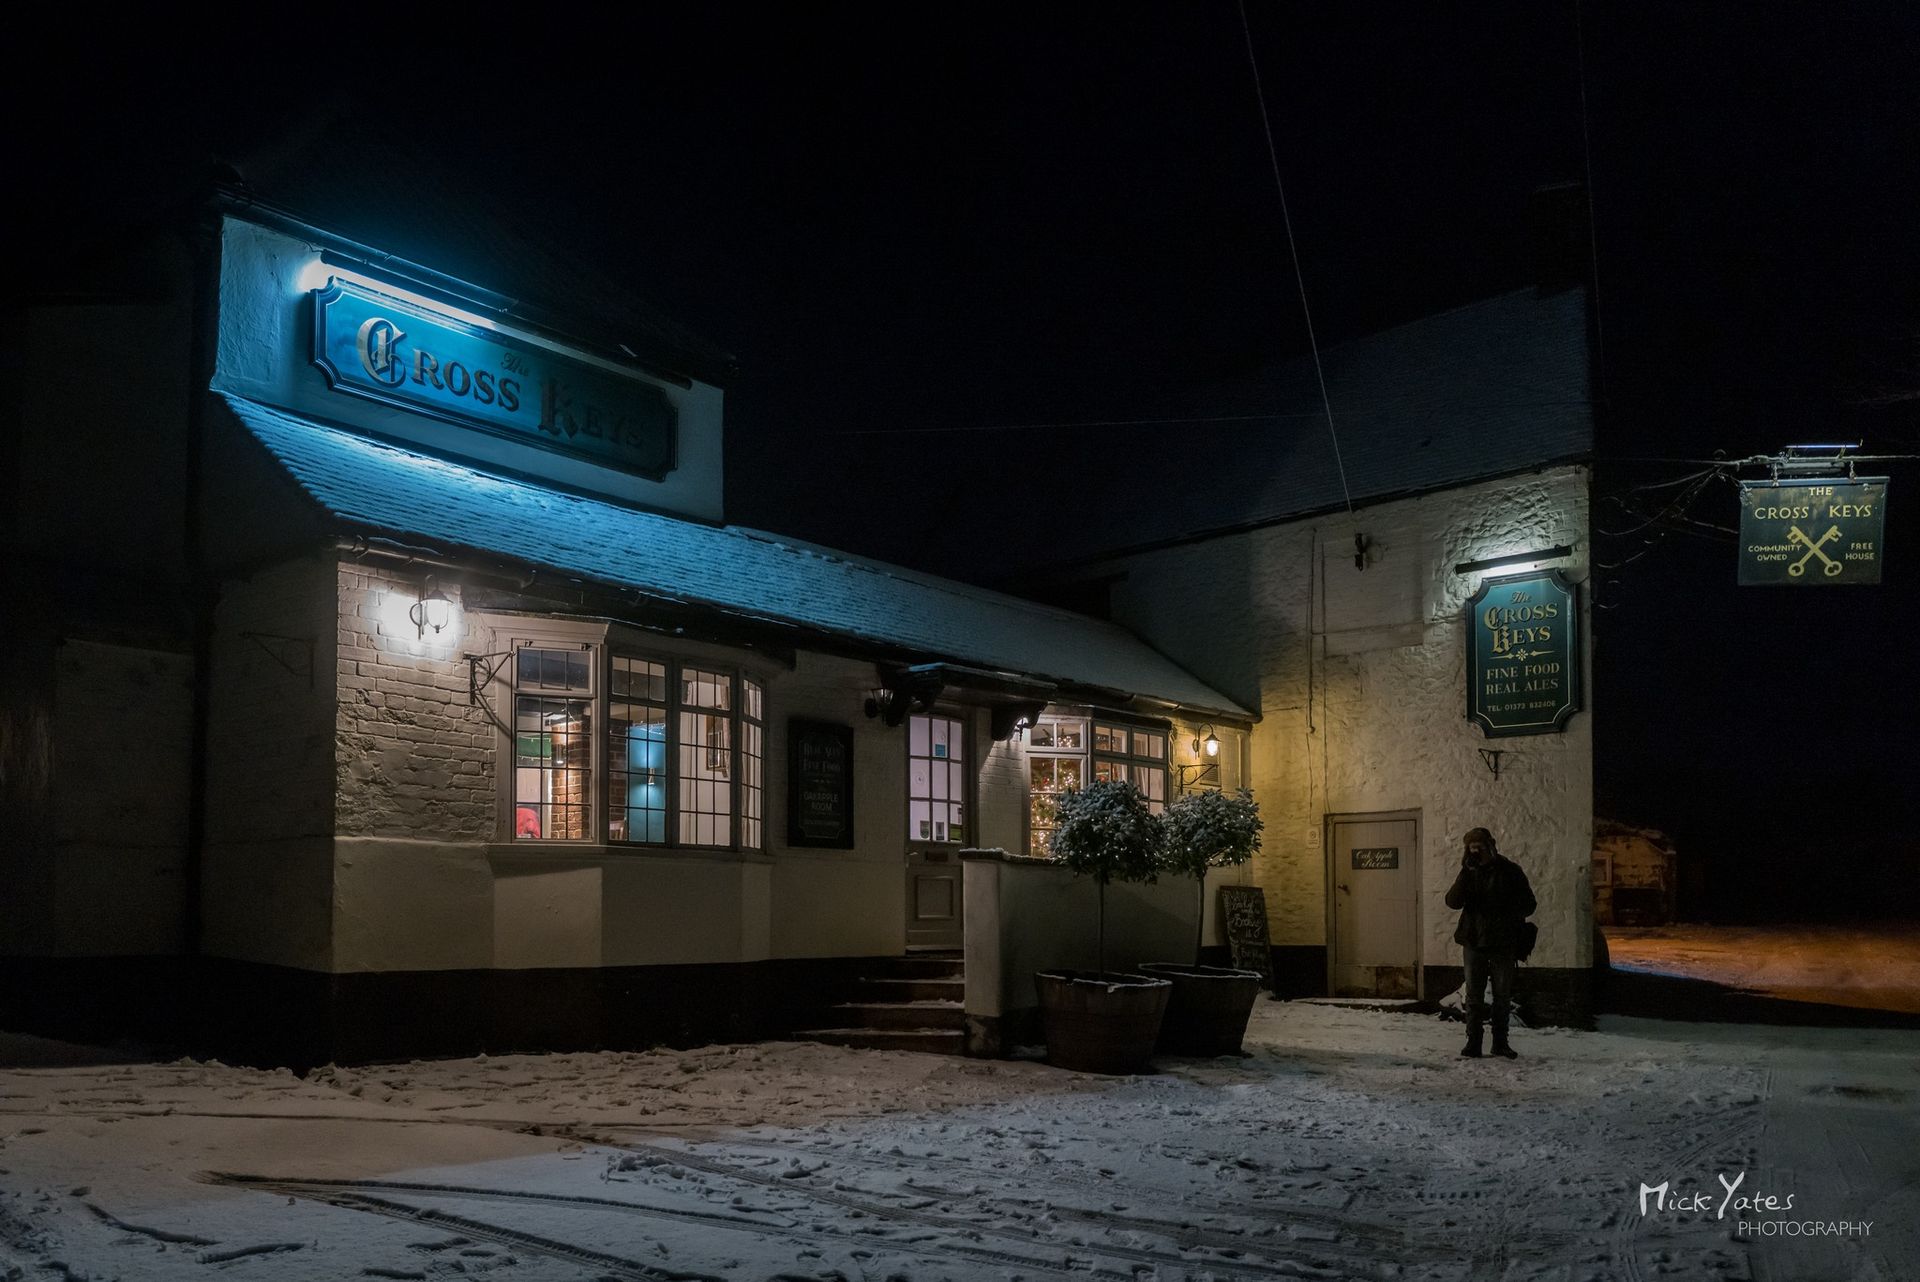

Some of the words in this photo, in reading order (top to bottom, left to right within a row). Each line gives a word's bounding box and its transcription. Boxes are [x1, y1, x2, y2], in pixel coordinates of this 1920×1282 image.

[356, 317, 521, 412] CROSS
[1808, 487, 1833, 496] THE
[1754, 506, 1809, 520] CROSS
[1829, 504, 1872, 518] KEYS
[1747, 543, 1803, 553] COMMUNITY
[1850, 542, 1873, 551] FREE
[1756, 553, 1788, 562] OWNED
[1845, 552, 1875, 561] HOUSE
[1510, 591, 1531, 604] The
[1484, 602, 1559, 630] CROSS
[1492, 625, 1552, 654] KEYS
[1486, 666, 1519, 680] FINE
[1525, 662, 1560, 677] FOOD
[1486, 682, 1521, 696] REAL
[1524, 678, 1559, 693] ALES
